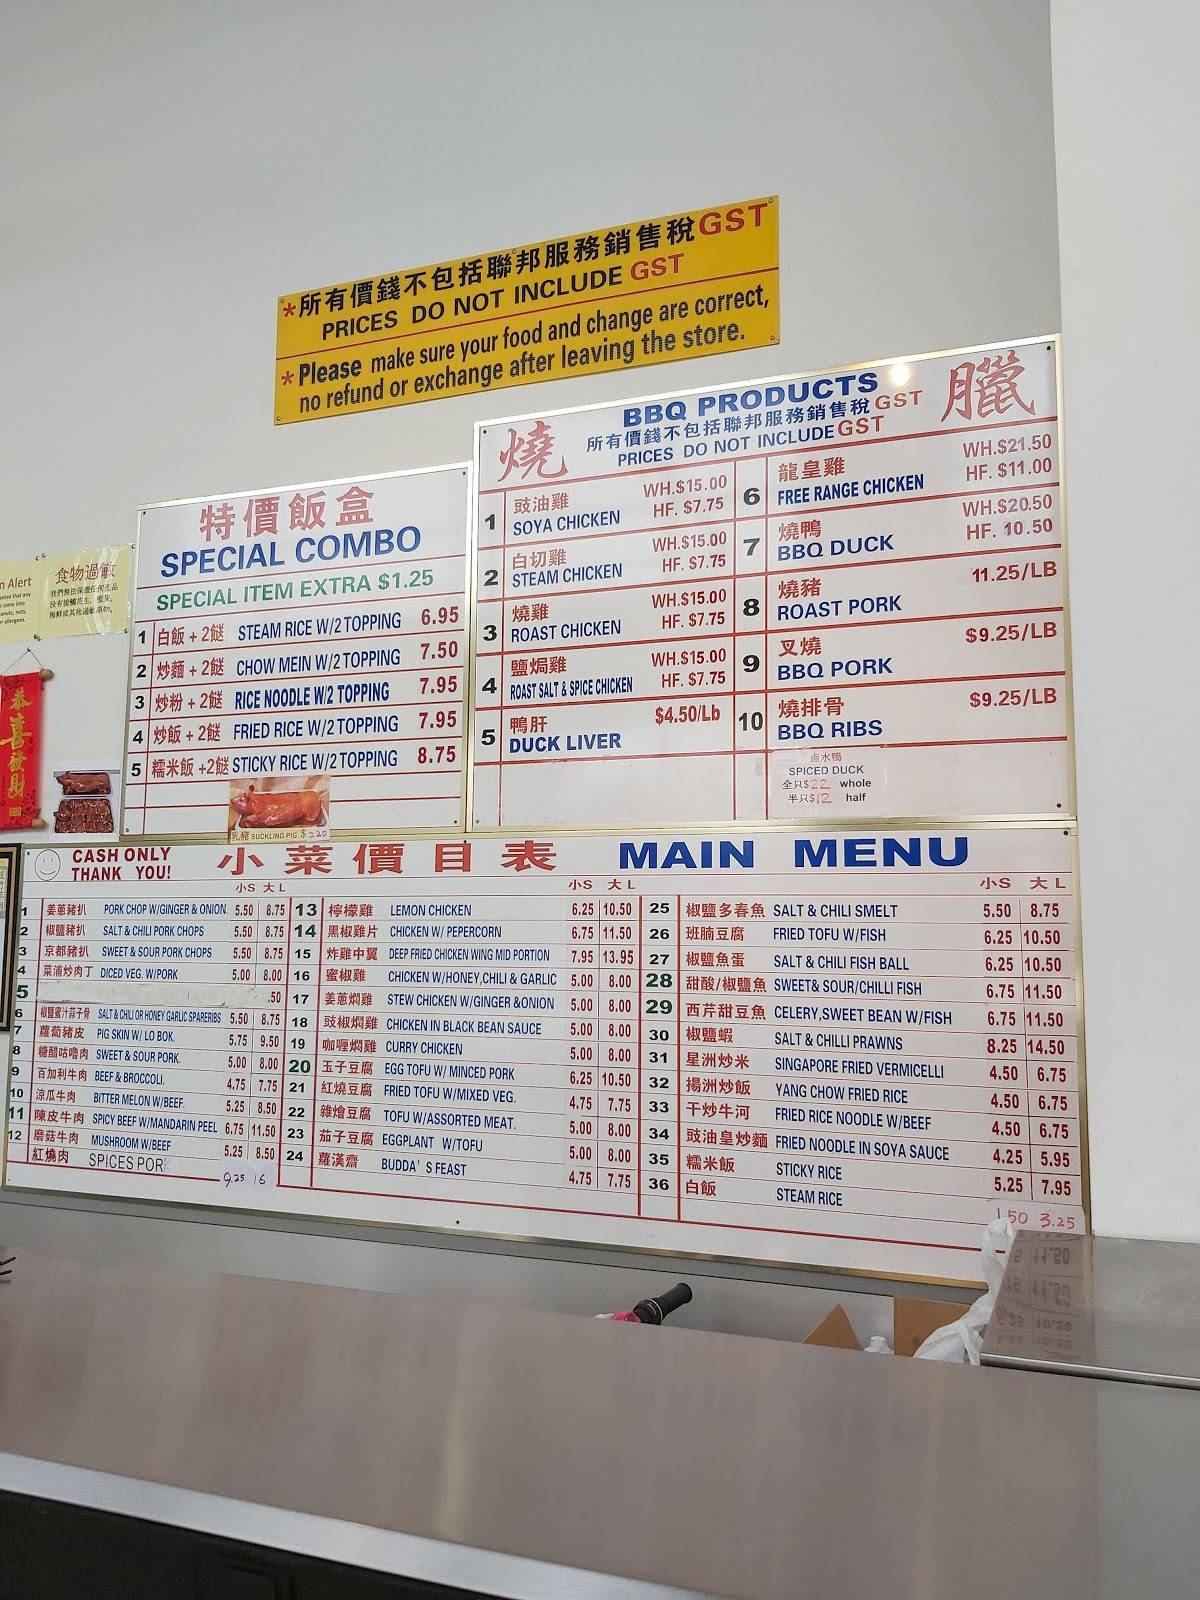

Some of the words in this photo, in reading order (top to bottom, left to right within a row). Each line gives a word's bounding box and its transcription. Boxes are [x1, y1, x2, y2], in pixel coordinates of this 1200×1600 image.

[699, 203, 768, 237] GST
[322, 310, 398, 340] PRICES
[411, 301, 444, 325] DO
[453, 289, 505, 318] NOT
[514, 266, 623, 304] INCLUDE
[630, 253, 684, 280] GST
[299, 358, 363, 387] Please
[371, 345, 414, 373] make
[419, 338, 455, 363] sure
[460, 331, 498, 361] your
[503, 320, 542, 350] food
[547, 313, 582, 345] and
[587, 307, 654, 342] change
[659, 302, 689, 322] are
[695, 285, 770, 317] correct,
[299, 391, 321, 414] no
[327, 376, 384, 408] refund
[389, 377, 410, 396] or
[414, 361, 503, 394] exchange
[509, 354, 553, 376] after
[561, 337, 635, 370] leaving
[642, 329, 675, 353] the
[682, 321, 745, 348] store.
[623, 401, 687, 428] BBQ
[698, 372, 878, 417] PRODUCTS
[875, 390, 922, 410] GST
[617, 448, 674, 467] PRICES
[683, 442, 708, 458] DO
[714, 436, 750, 455] NOT
[758, 424, 834, 448] INCLUDE
[838, 415, 884, 436] GST
[963, 433, 1051, 458] WH.$21.50
[778, 457, 845, 482] 龍皇雞
[966, 463, 992, 481] HF.
[998, 458, 1051, 478] $11.00
[643, 475, 727, 498] WH.$15.00
[778, 486, 810, 505] FREE
[814, 481, 859, 501] RANGE
[863, 474, 924, 495] CHICKEN
[743, 488, 760, 505] 6
[200, 486, 374, 541] 特價飯盒
[653, 502, 677, 518] HF.
[683, 497, 723, 515] $7.75
[484, 514, 496, 530] 1
[513, 518, 553, 536] SOYA
[556, 510, 620, 532] CHICKEN
[161, 544, 284, 577] SPECIAL
[295, 526, 421, 562] COMBO
[972, 561, 1057, 583] 11.25/LB
[8, 577, 32, 589] Alert
[156, 588, 237, 611] SPECIAL
[243, 582, 292, 602] ITEM
[301, 574, 371, 597] EXTRA
[378, 570, 433, 591] $1.25
[778, 577, 821, 599] 燒豬
[743, 599, 760, 616] 8
[778, 601, 842, 621] ROAST
[849, 595, 901, 614] PORK
[420, 675, 458, 695] 7.95
[135, 696, 145, 709] 3
[155, 692, 183, 712] 炒粉
[235, 690, 260, 710] RICE
[264, 686, 310, 708] NOODLE
[338, 681, 390, 703] TOPPING
[970, 687, 1057, 708] $9.25/LB
[778, 697, 844, 719] 燒排骨
[738, 712, 763, 731] 10
[778, 723, 824, 740] BBQ
[832, 720, 882, 737] RIBS
[789, 767, 828, 775] SPICED
[833, 766, 864, 774] DUCK
[840, 779, 871, 787] whole
[846, 793, 866, 801] half
[72, 848, 118, 863] CASH
[125, 847, 171, 862] ONLY
[217, 841, 557, 876] 小菜價目表
[619, 840, 754, 869] MAIN
[794, 837, 969, 866] MENU
[72, 867, 122, 881] THANK
[136, 865, 171, 880] YOU!
[295, 903, 317, 917] 13
[329, 904, 373, 918] 檸檬雞
[391, 904, 428, 916] LEMON
[429, 904, 471, 916] CHICKEN
[572, 903, 594, 916] 6.25
[604, 903, 632, 916] 10.50
[649, 903, 670, 913] 25
[686, 902, 765, 918] 椒鹽多春魚
[773, 904, 802, 917] SALT
[807, 905, 817, 917] &
[820, 905, 851, 917] CHILI
[854, 904, 898, 919] SMELT
[983, 904, 1012, 918] 5.50
[1030, 903, 1060, 918] 8.75
[19, 947, 26, 956] 3
[44, 945, 89, 957] 京都豬扒
[102, 946, 128, 957] SWEET
[130, 947, 136, 957] &
[138, 947, 160, 957] SOUR
[162, 947, 183, 957] PORK
[185, 947, 212, 958] CHOPS
[233, 947, 251, 959] 5.50
[264, 948, 283, 960] 8.75
[649, 1052, 669, 1063] 31
[686, 1052, 750, 1069] 星洲炒米
[775, 1057, 838, 1073] SINGAPORE
[842, 1060, 873, 1075] FRIED
[876, 1062, 944, 1079] VERMICELLI
[989, 1066, 1018, 1081] 4.50
[1037, 1067, 1067, 1083] 6.75
[10, 1089, 23, 1098] 10
[94, 1092, 119, 1104] BITTER
[122, 1094, 150, 1106] MELON
[226, 1101, 245, 1112] 5.25
[258, 1102, 277, 1115] 8.50
[287, 1128, 304, 1139] 23
[319, 1130, 374, 1146] 茄子豆腐
[382, 1133, 434, 1149] EGGPLANT
[442, 1137, 483, 1152] W/TOFU
[32, 1148, 69, 1163] 紅燒肉
[89, 1153, 134, 1170] SPICES
[569, 1146, 592, 1161] 5.00
[608, 1148, 631, 1163] 8.00
[649, 1178, 669, 1190] 36
[686, 1180, 716, 1196] 白飯
[776, 1188, 815, 1204] STEAM
[818, 1191, 843, 1206] RICE
